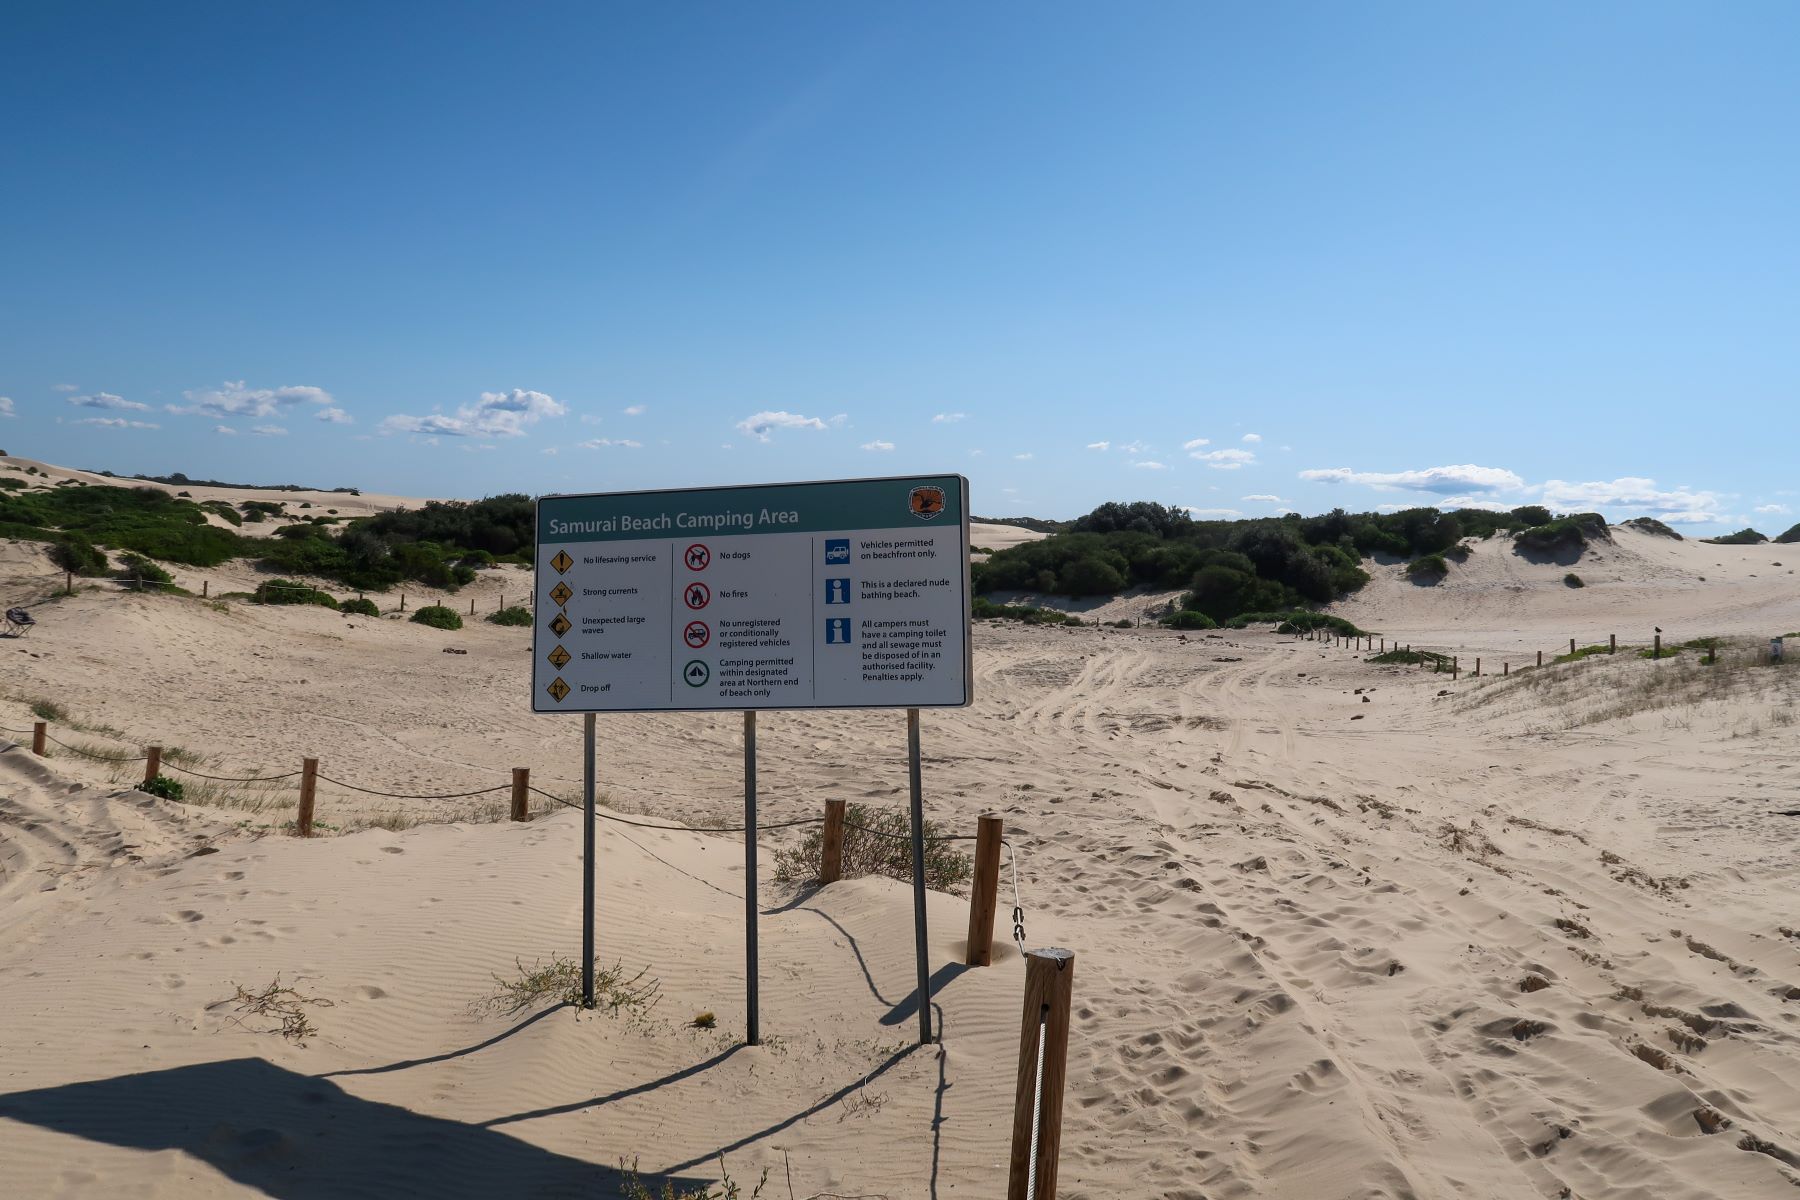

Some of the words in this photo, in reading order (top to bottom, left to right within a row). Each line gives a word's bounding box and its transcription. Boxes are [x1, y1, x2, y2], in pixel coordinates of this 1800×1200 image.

[549, 516, 616, 534] Samurai
[621, 513, 671, 531] Beach
[676, 510, 754, 530] Camping
[758, 508, 799, 525] Area
[860, 541, 892, 549] Vehicles
[894, 539, 934, 549] permitted
[732, 551, 751, 560] dogs
[873, 551, 916, 559] beachfront
[917, 549, 937, 558] only.
[595, 556, 629, 564] lifesaving
[861, 581, 877, 589] This
[893, 579, 927, 587] declared
[929, 578, 949, 586] nude
[583, 588, 606, 596] Strong
[732, 590, 748, 598] fires
[861, 591, 892, 600] bathing
[894, 590, 920, 598] beach.
[582, 616, 625, 626] Unexpected
[627, 616, 645, 624] large
[732, 619, 781, 628] unregistered
[862, 620, 872, 628] All
[873, 621, 907, 629] campers
[729, 629, 779, 638] conditionally
[889, 630, 923, 639] camping
[925, 629, 946, 637] toilet
[720, 639, 758, 649] registered
[890, 642, 920, 650] sewage
[581, 652, 610, 660] Shallow
[874, 651, 909, 660] disposed
[720, 659, 754, 668] Camping
[755, 658, 794, 667] permitted
[862, 662, 905, 670] authorised
[906, 662, 935, 671] facility.
[745, 668, 788, 678] designated
[862, 673, 898, 681] Penalties
[900, 673, 924, 682] apply.
[783, 678, 799, 686] end
[580, 685, 599, 693] Drop
[600, 684, 611, 692] off
[753, 688, 770, 698] only
